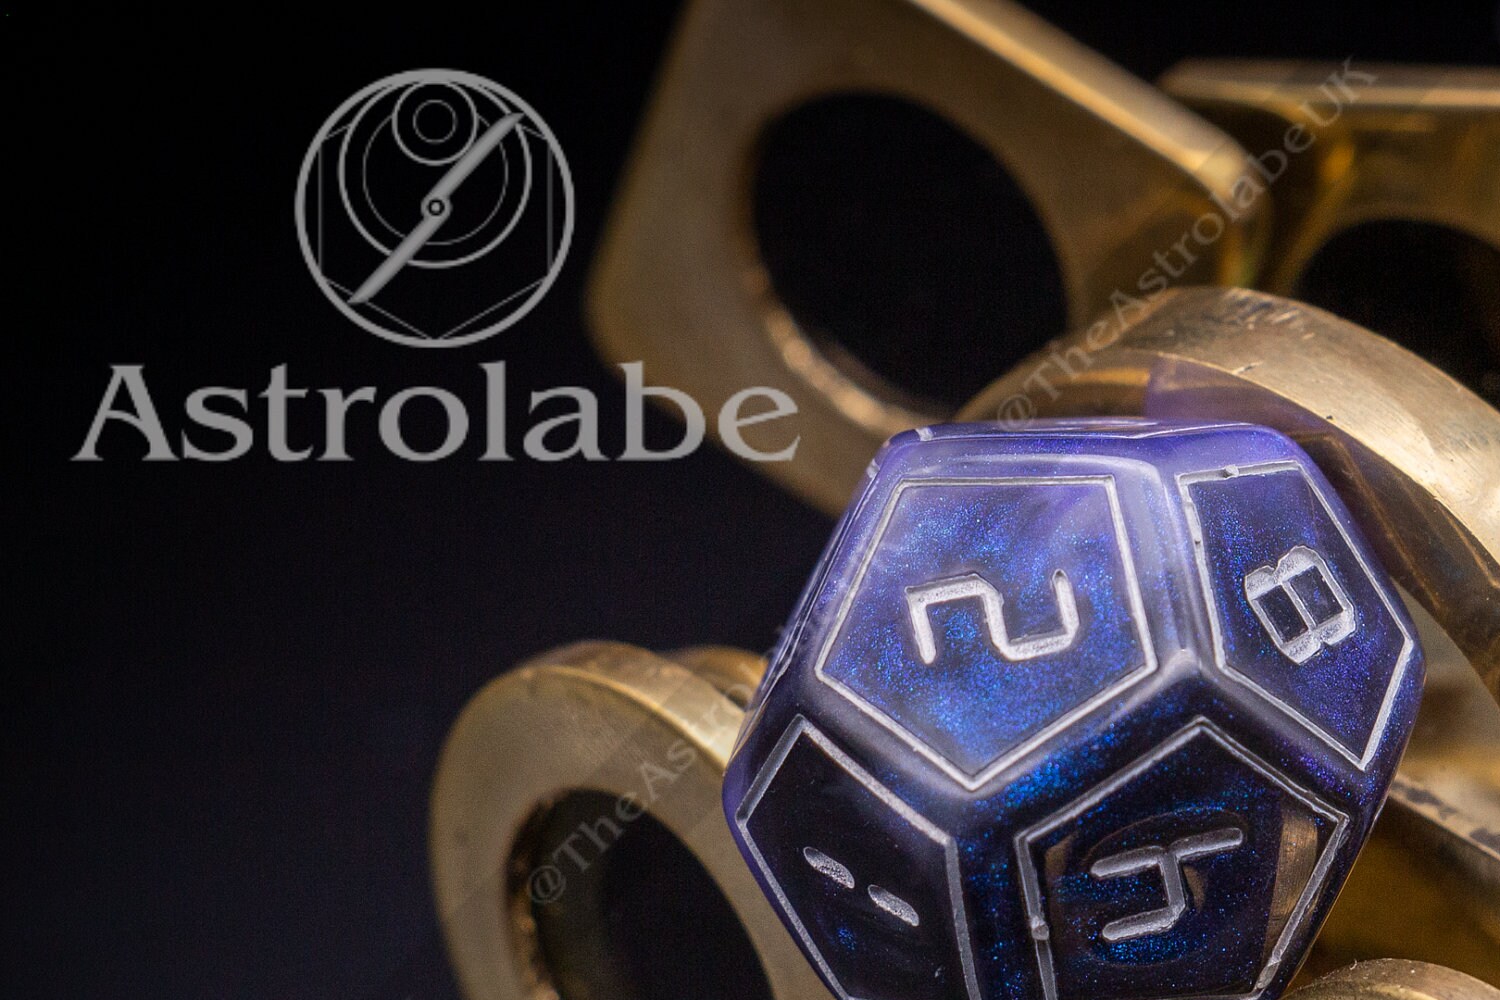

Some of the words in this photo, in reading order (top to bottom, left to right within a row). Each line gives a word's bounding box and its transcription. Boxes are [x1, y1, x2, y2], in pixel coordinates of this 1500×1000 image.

[905, 569, 1080, 664] 2
[1244, 545, 1356, 665] 8
[1091, 827, 1244, 942] 4
